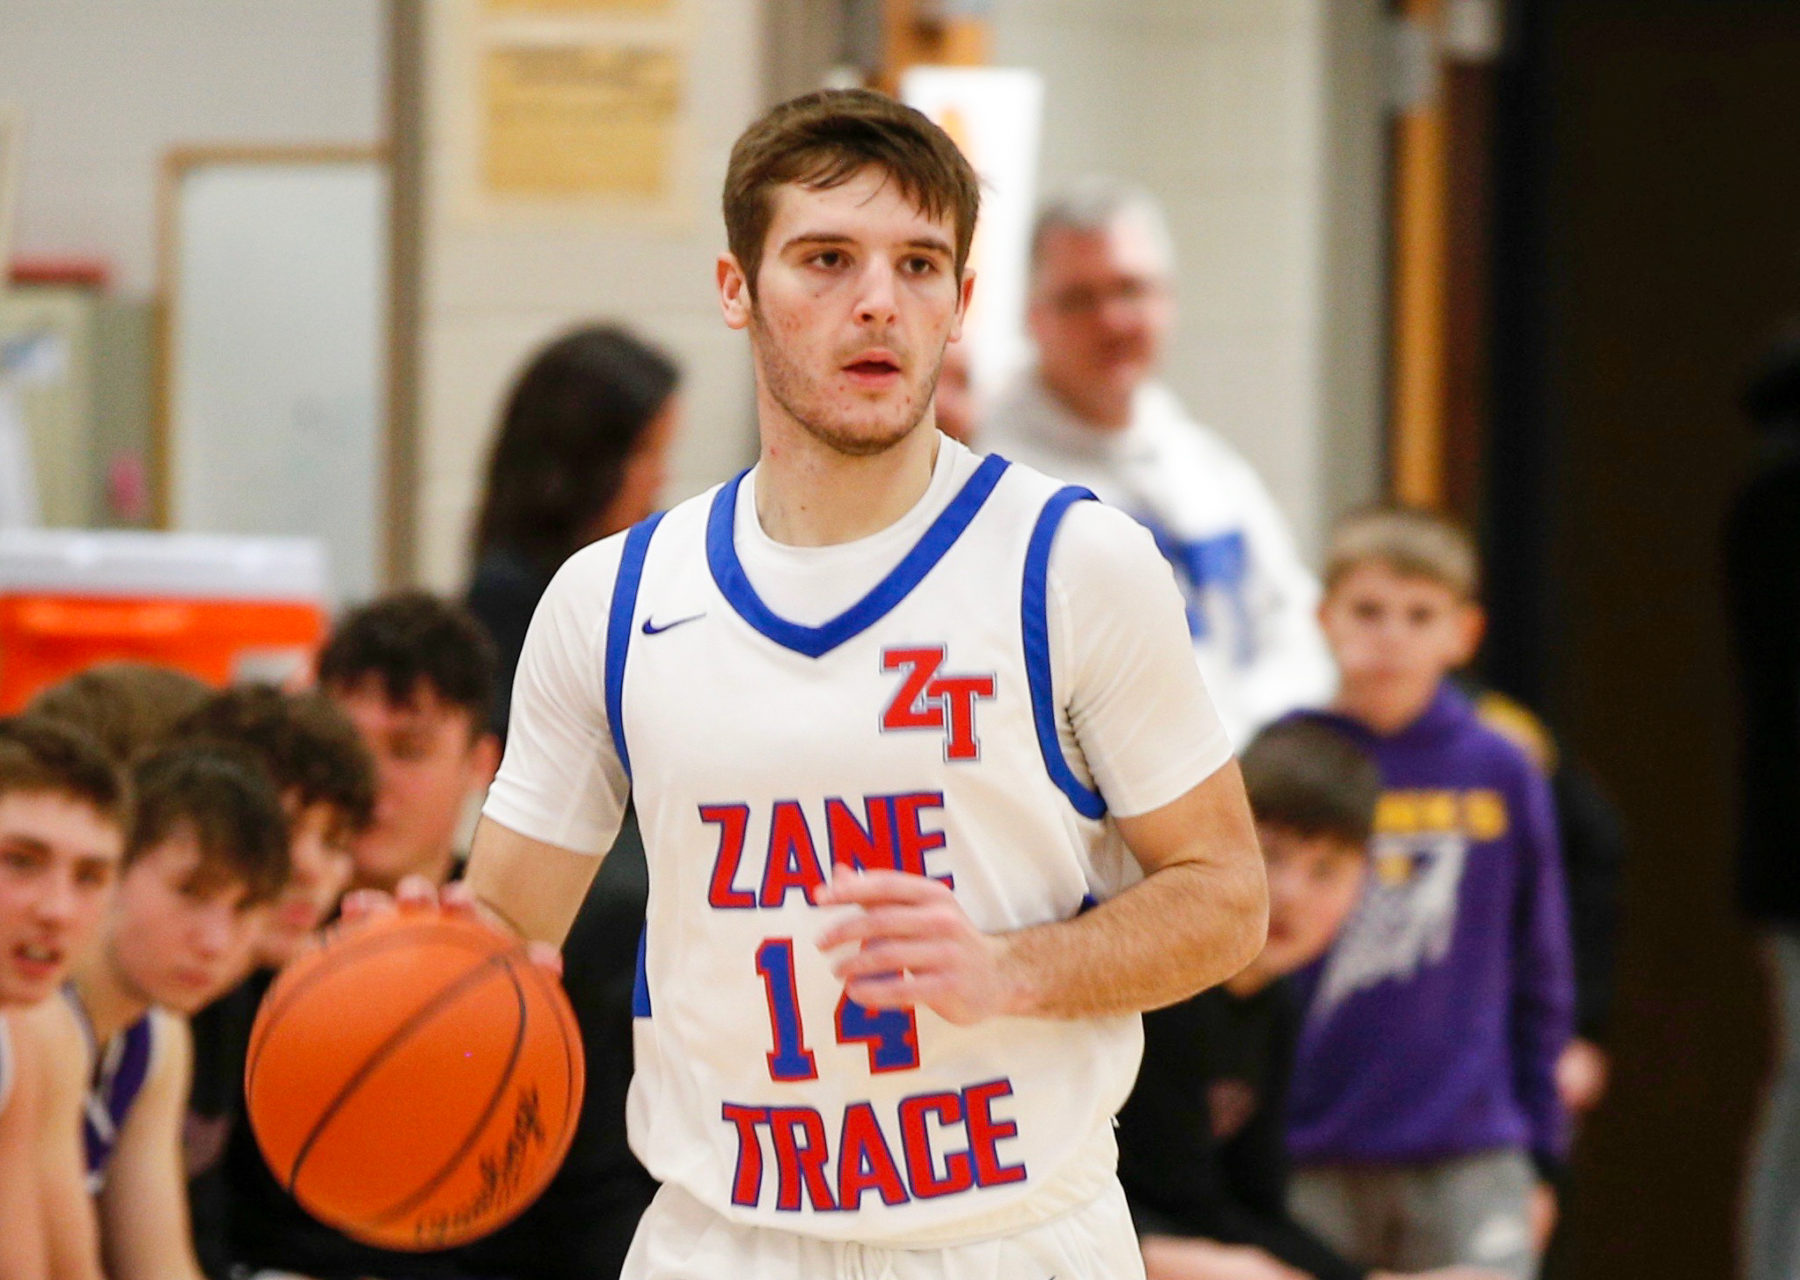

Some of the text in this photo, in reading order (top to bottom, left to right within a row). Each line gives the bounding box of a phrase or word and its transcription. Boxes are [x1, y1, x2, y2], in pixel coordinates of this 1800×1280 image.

[879, 643, 996, 762] ZT
[698, 791, 954, 909] ZANE
[722, 1077, 1028, 1213] TRACE
